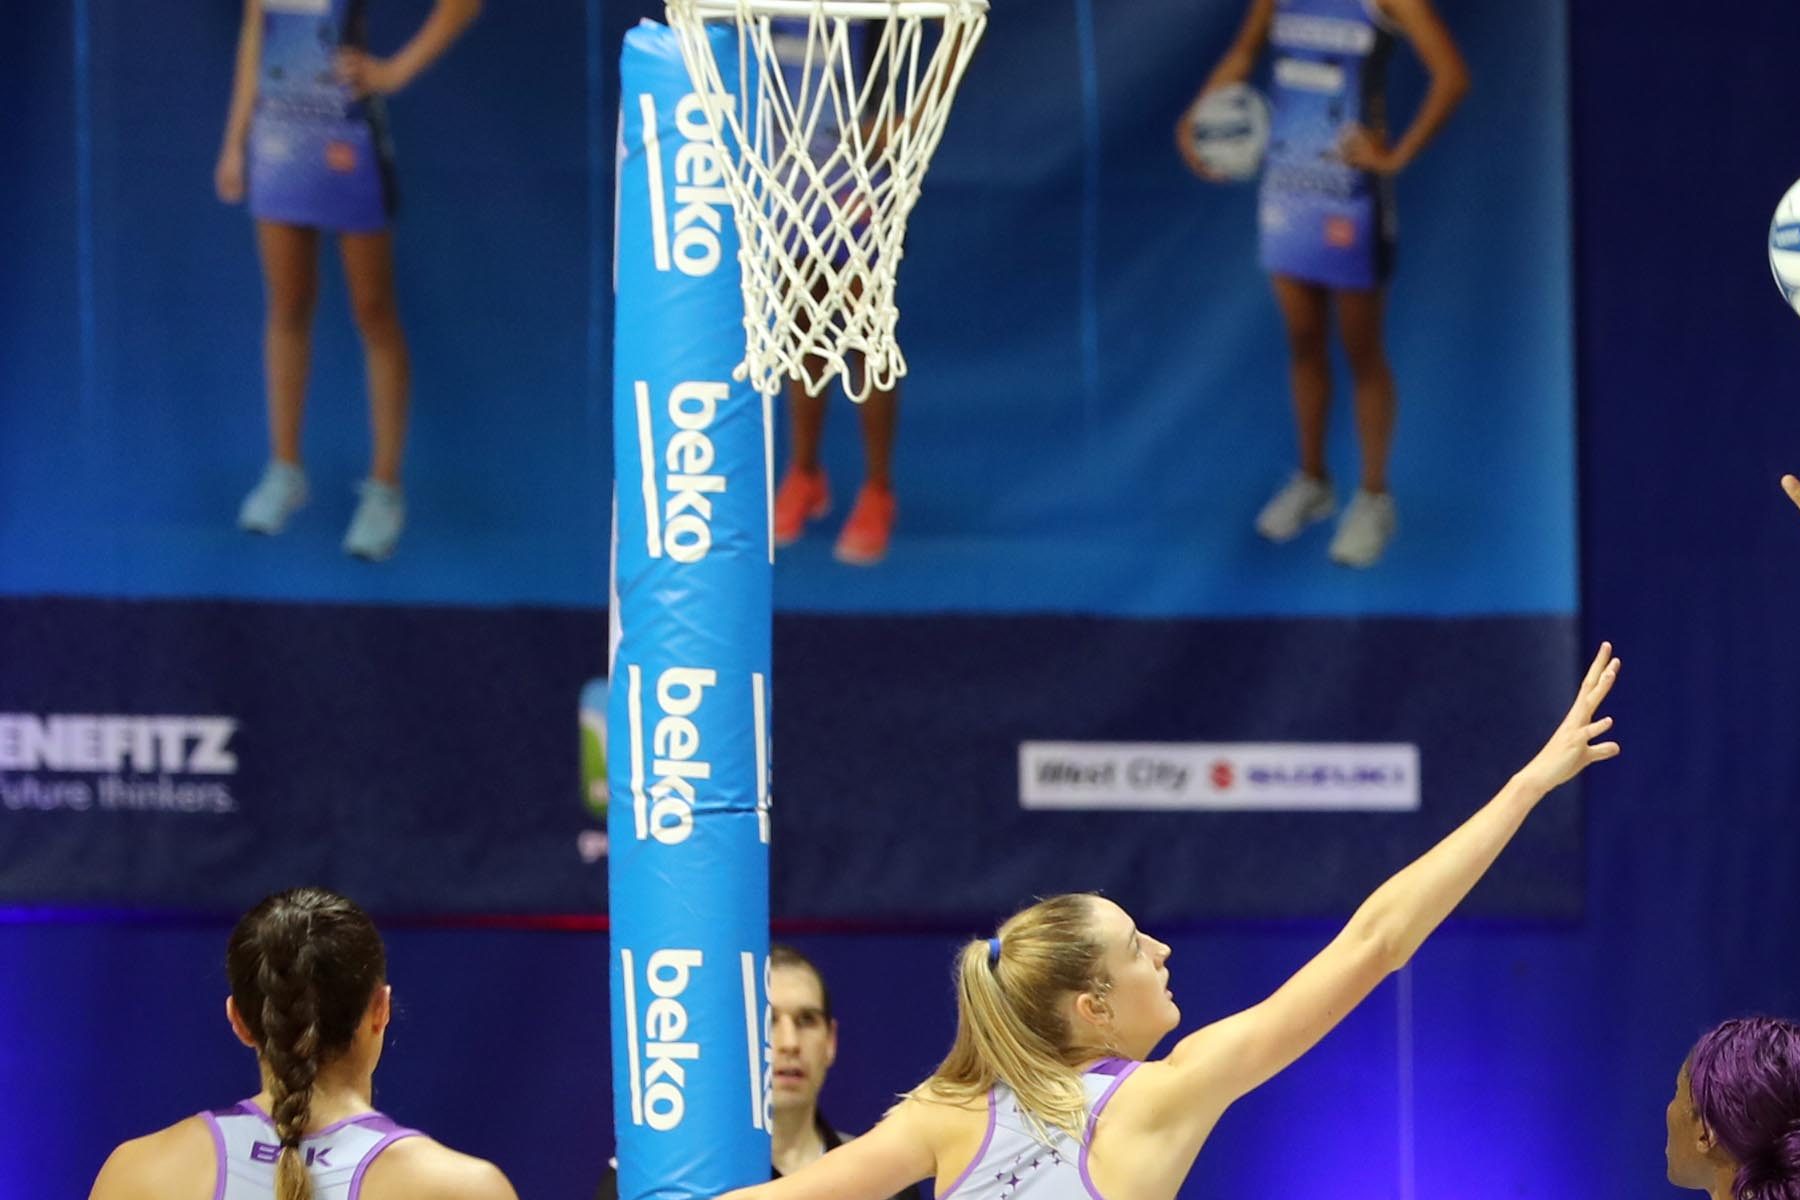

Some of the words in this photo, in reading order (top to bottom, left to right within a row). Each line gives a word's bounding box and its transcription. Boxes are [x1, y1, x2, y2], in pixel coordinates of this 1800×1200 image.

[673, 92, 736, 277] beko
[664, 381, 729, 563] beko
[649, 667, 717, 846] beko
[643, 949, 703, 1132] beko
[250, 1140, 333, 1167] BK
